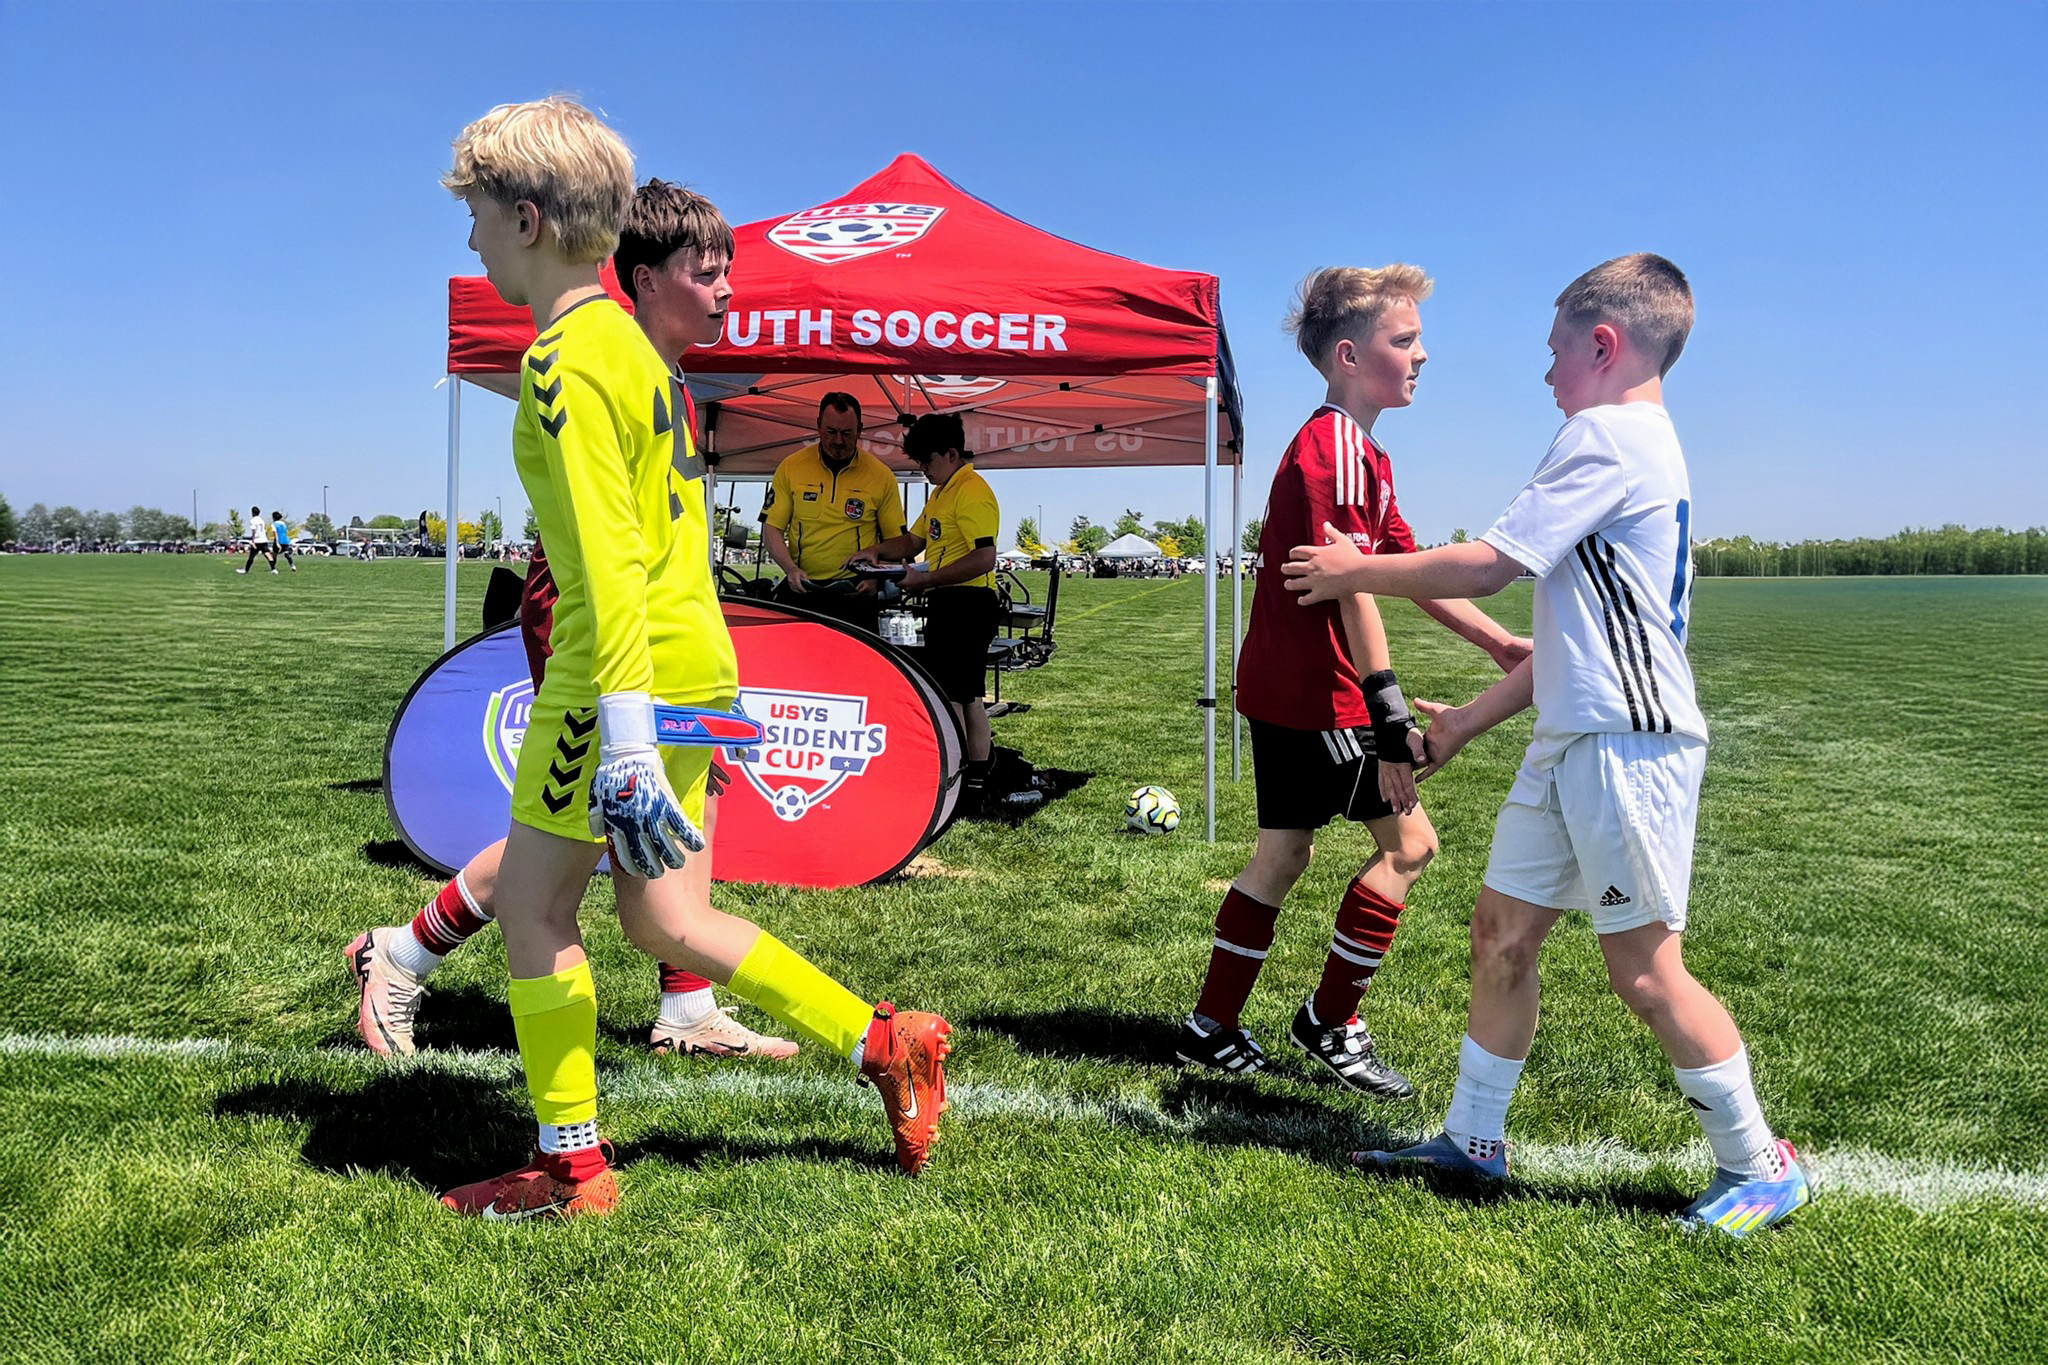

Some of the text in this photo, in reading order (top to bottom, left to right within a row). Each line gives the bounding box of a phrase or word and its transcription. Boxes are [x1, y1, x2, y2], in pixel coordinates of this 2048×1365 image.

[799, 204, 938, 218] USYS
[694, 309, 1069, 352] UTH SOCCER
[770, 703, 829, 723] USYS
[766, 725, 884, 753] SIDENTS
[765, 748, 825, 771] CUP
[1600, 896, 1631, 907] adidas
